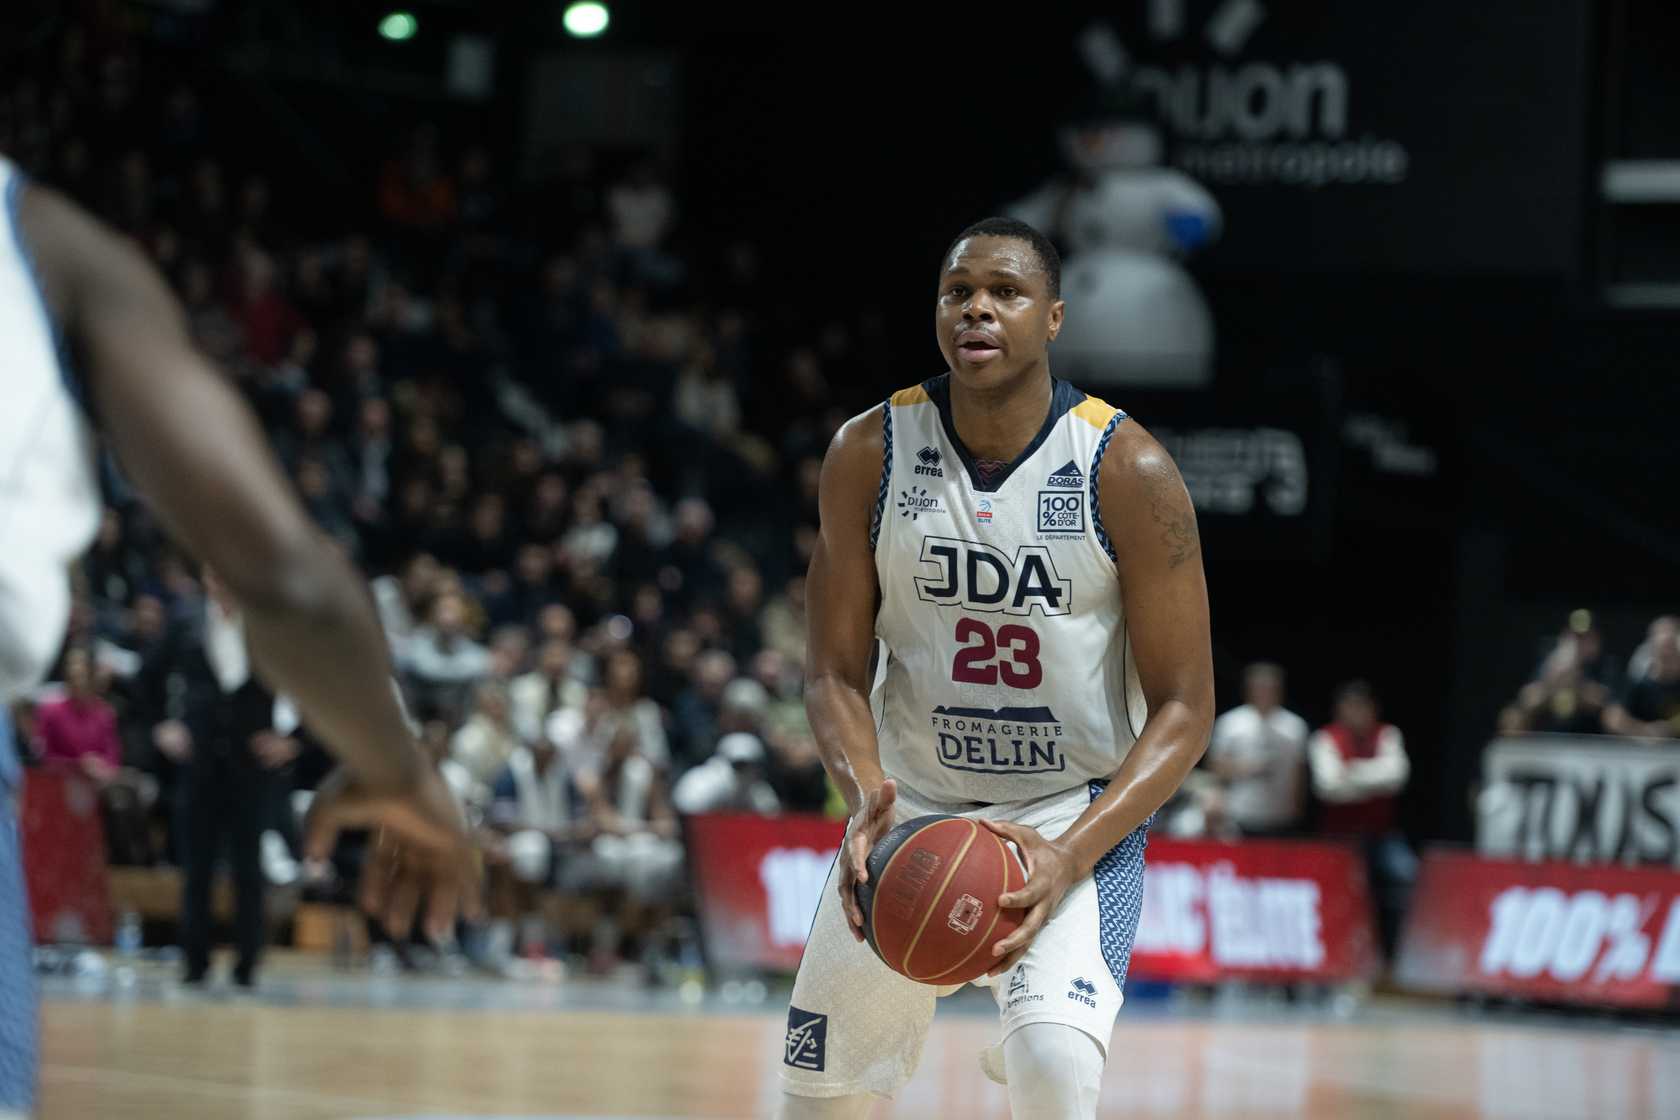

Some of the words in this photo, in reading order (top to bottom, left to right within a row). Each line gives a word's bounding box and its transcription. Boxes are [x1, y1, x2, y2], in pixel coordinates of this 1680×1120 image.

[914, 465, 943, 477] errea
[1047, 476, 1084, 487] DORAS
[1042, 497, 1080, 511] 100
[1042, 511, 1057, 526] %
[919, 541, 1067, 612] JDA
[951, 617, 1043, 690] 23
[932, 717, 1063, 736] FROMAGERIE
[937, 732, 1056, 767] DELIN
[1067, 991, 1096, 1009] errea
